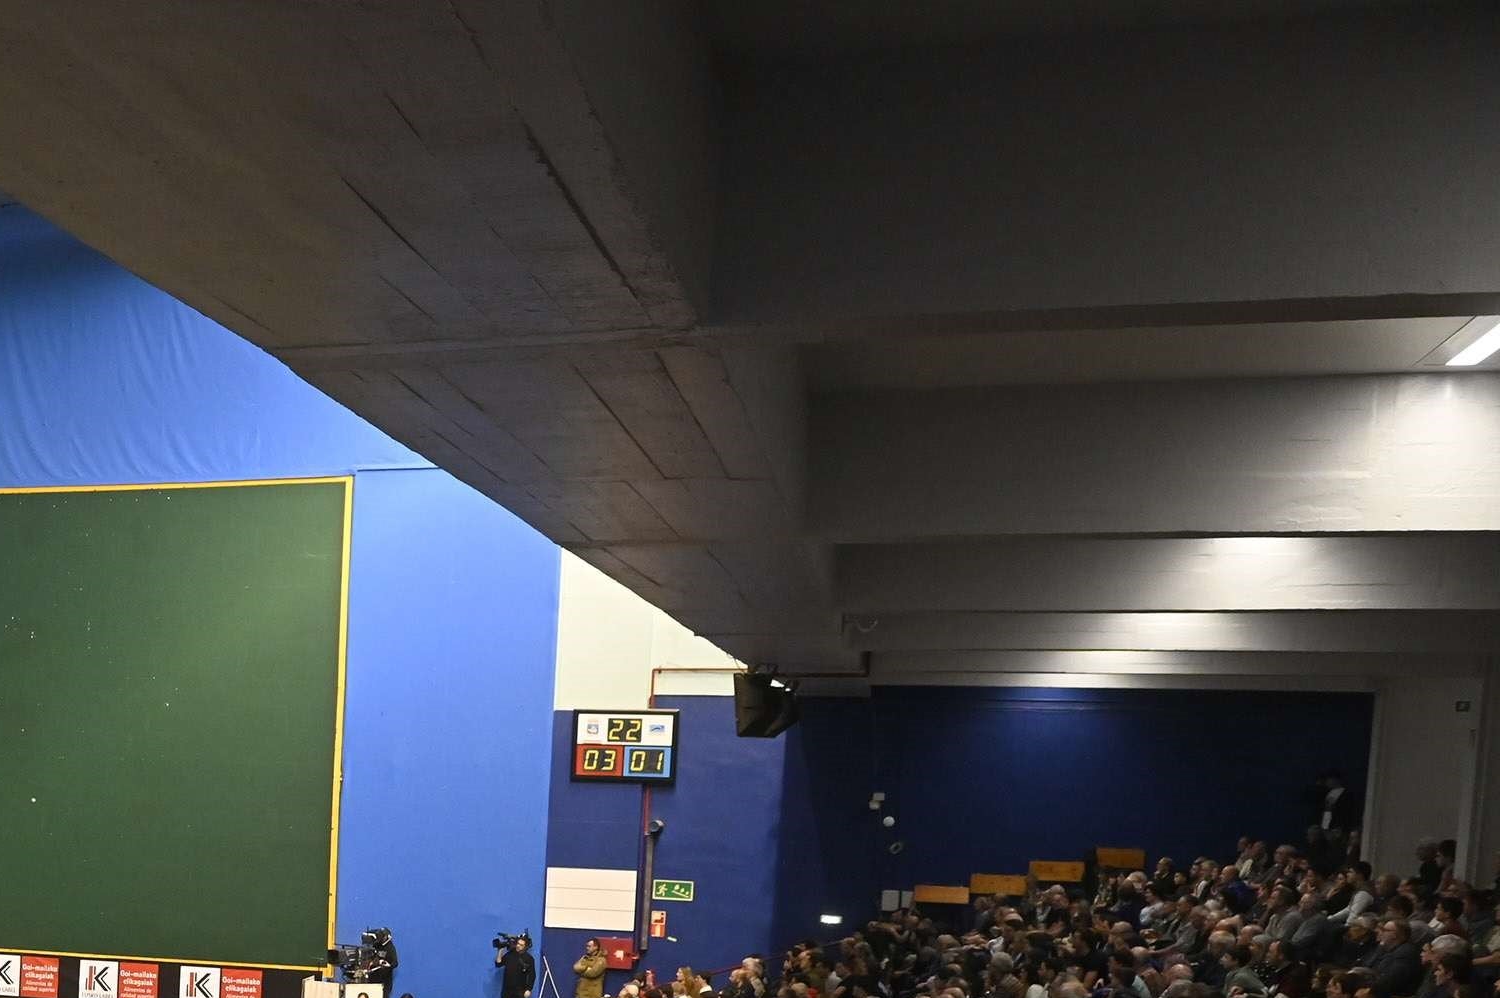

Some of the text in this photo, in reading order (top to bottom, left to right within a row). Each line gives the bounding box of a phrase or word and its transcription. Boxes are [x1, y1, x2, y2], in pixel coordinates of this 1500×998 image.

[608, 719, 642, 741] 22
[583, 749, 616, 771] 03
[630, 750, 664, 772] 01
[120, 969, 157, 979] Goi-mailako
[123, 978, 154, 987] elikagaiak
[222, 976, 261, 986] Goi-mailako
[225, 985, 257, 993] elikagaiak
